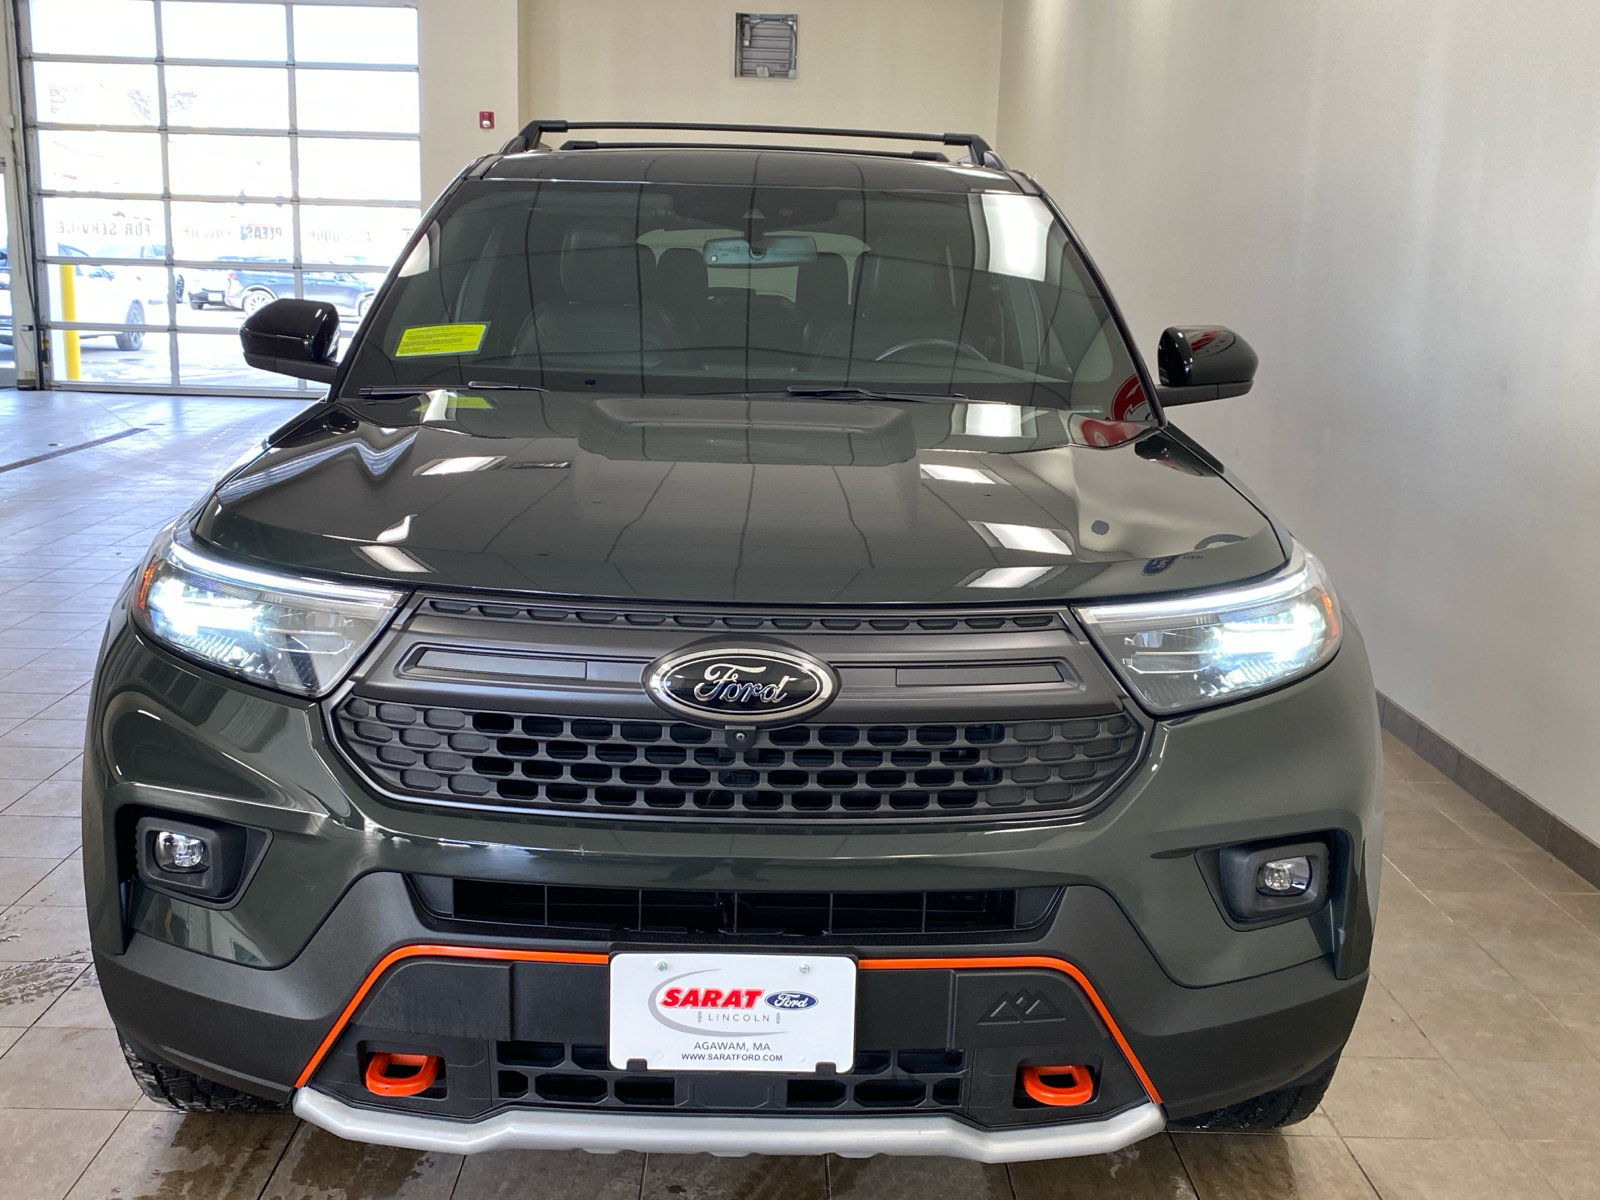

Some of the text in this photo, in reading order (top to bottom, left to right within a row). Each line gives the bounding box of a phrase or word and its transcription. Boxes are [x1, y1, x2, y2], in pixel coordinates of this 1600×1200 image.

[693, 663, 790, 704] Ford
[660, 987, 809, 1010] SARAT Ford
[707, 1013, 770, 1022] LINCOLN
[693, 1041, 771, 1052] AGAWAM, MA
[681, 1053, 783, 1062] WWW.SARATFORD.COM
